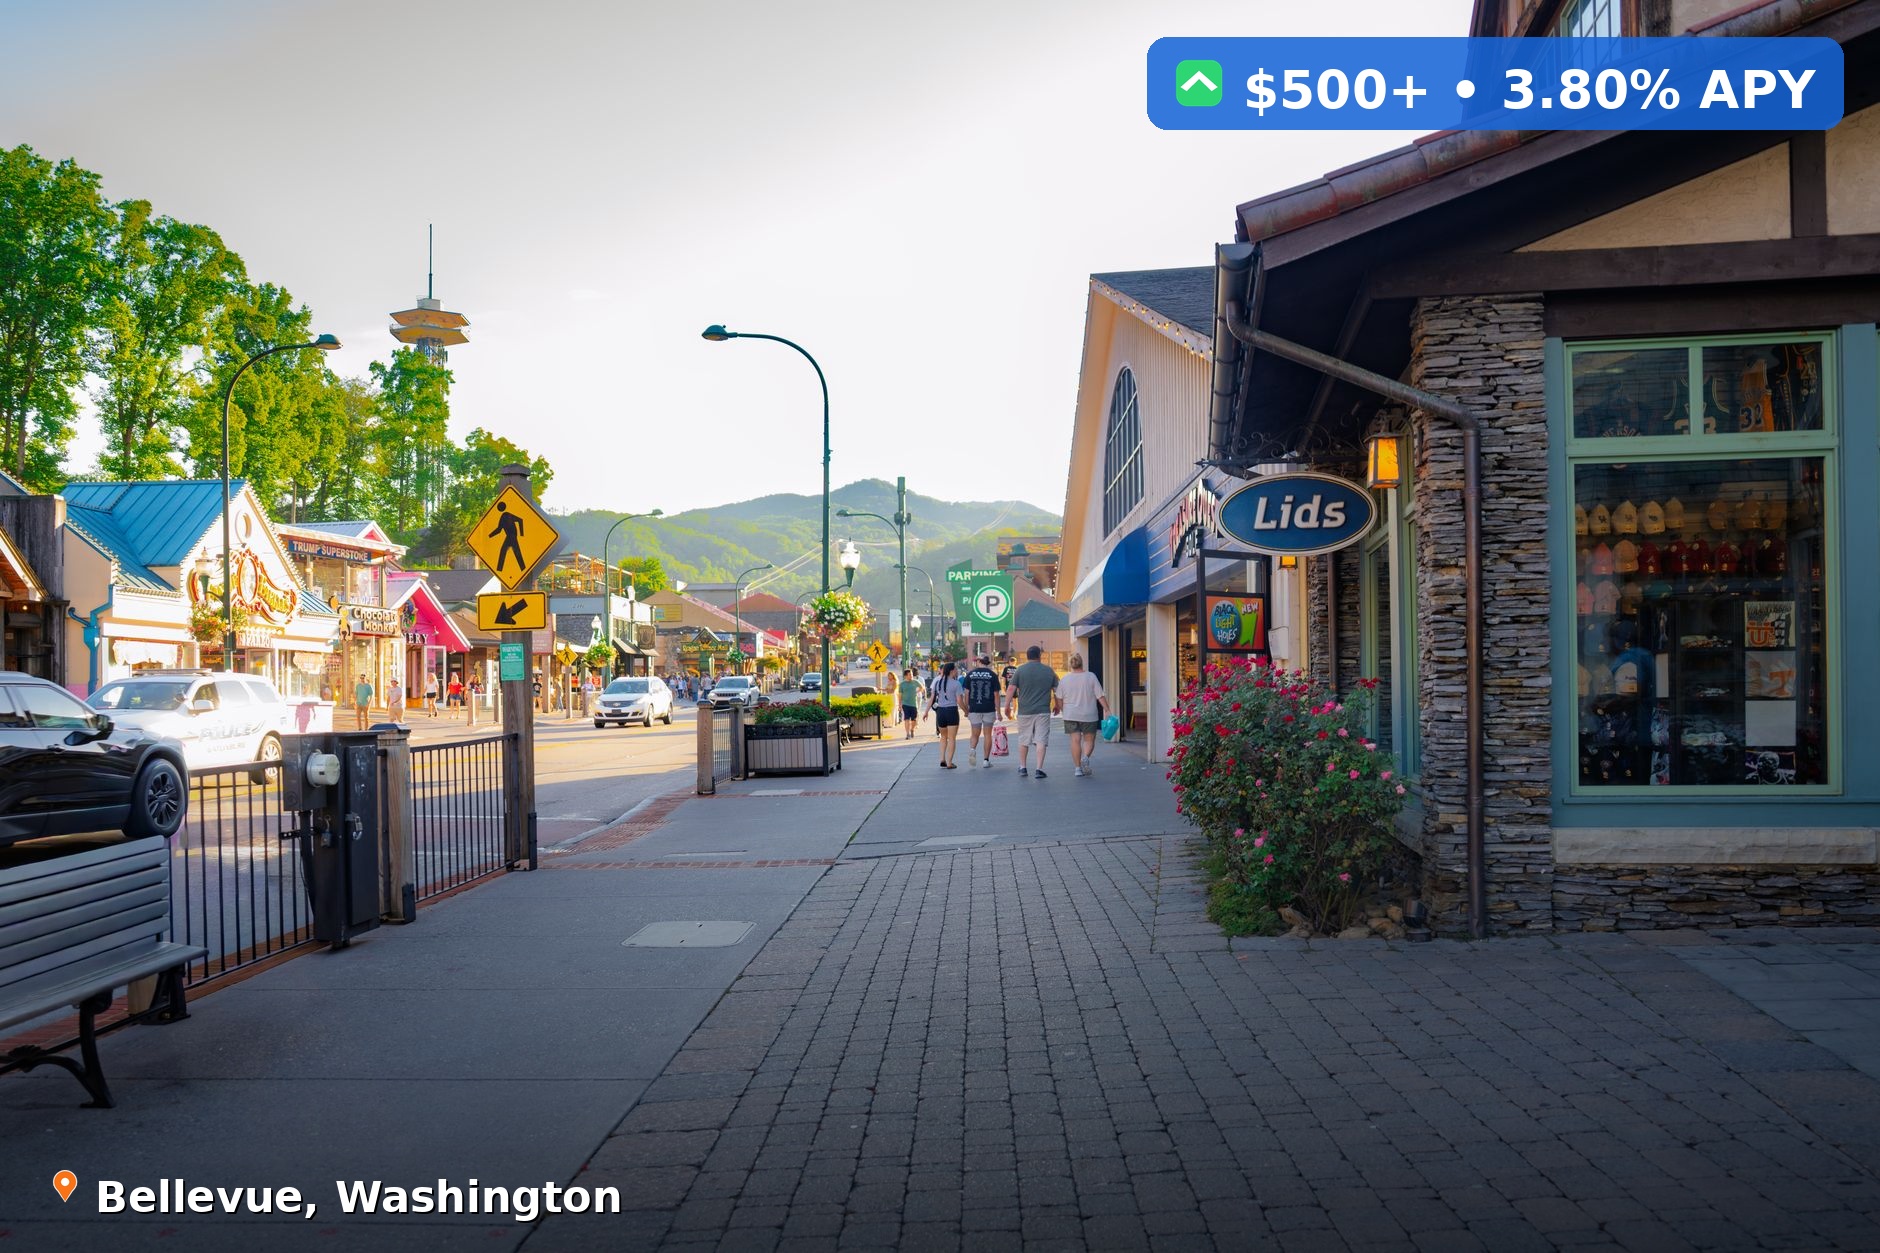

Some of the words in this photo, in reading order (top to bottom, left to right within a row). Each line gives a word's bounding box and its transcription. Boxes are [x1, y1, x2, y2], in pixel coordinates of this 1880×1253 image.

[1253, 494, 1346, 530] Lids
[292, 541, 321, 554] TRUMP
[321, 544, 368, 561] SUPERSTORE
[986, 595, 1000, 613] P
[1241, 602, 1259, 615] NEW
[363, 620, 398, 635] Monkey
[1217, 628, 1238, 641] HOLES
